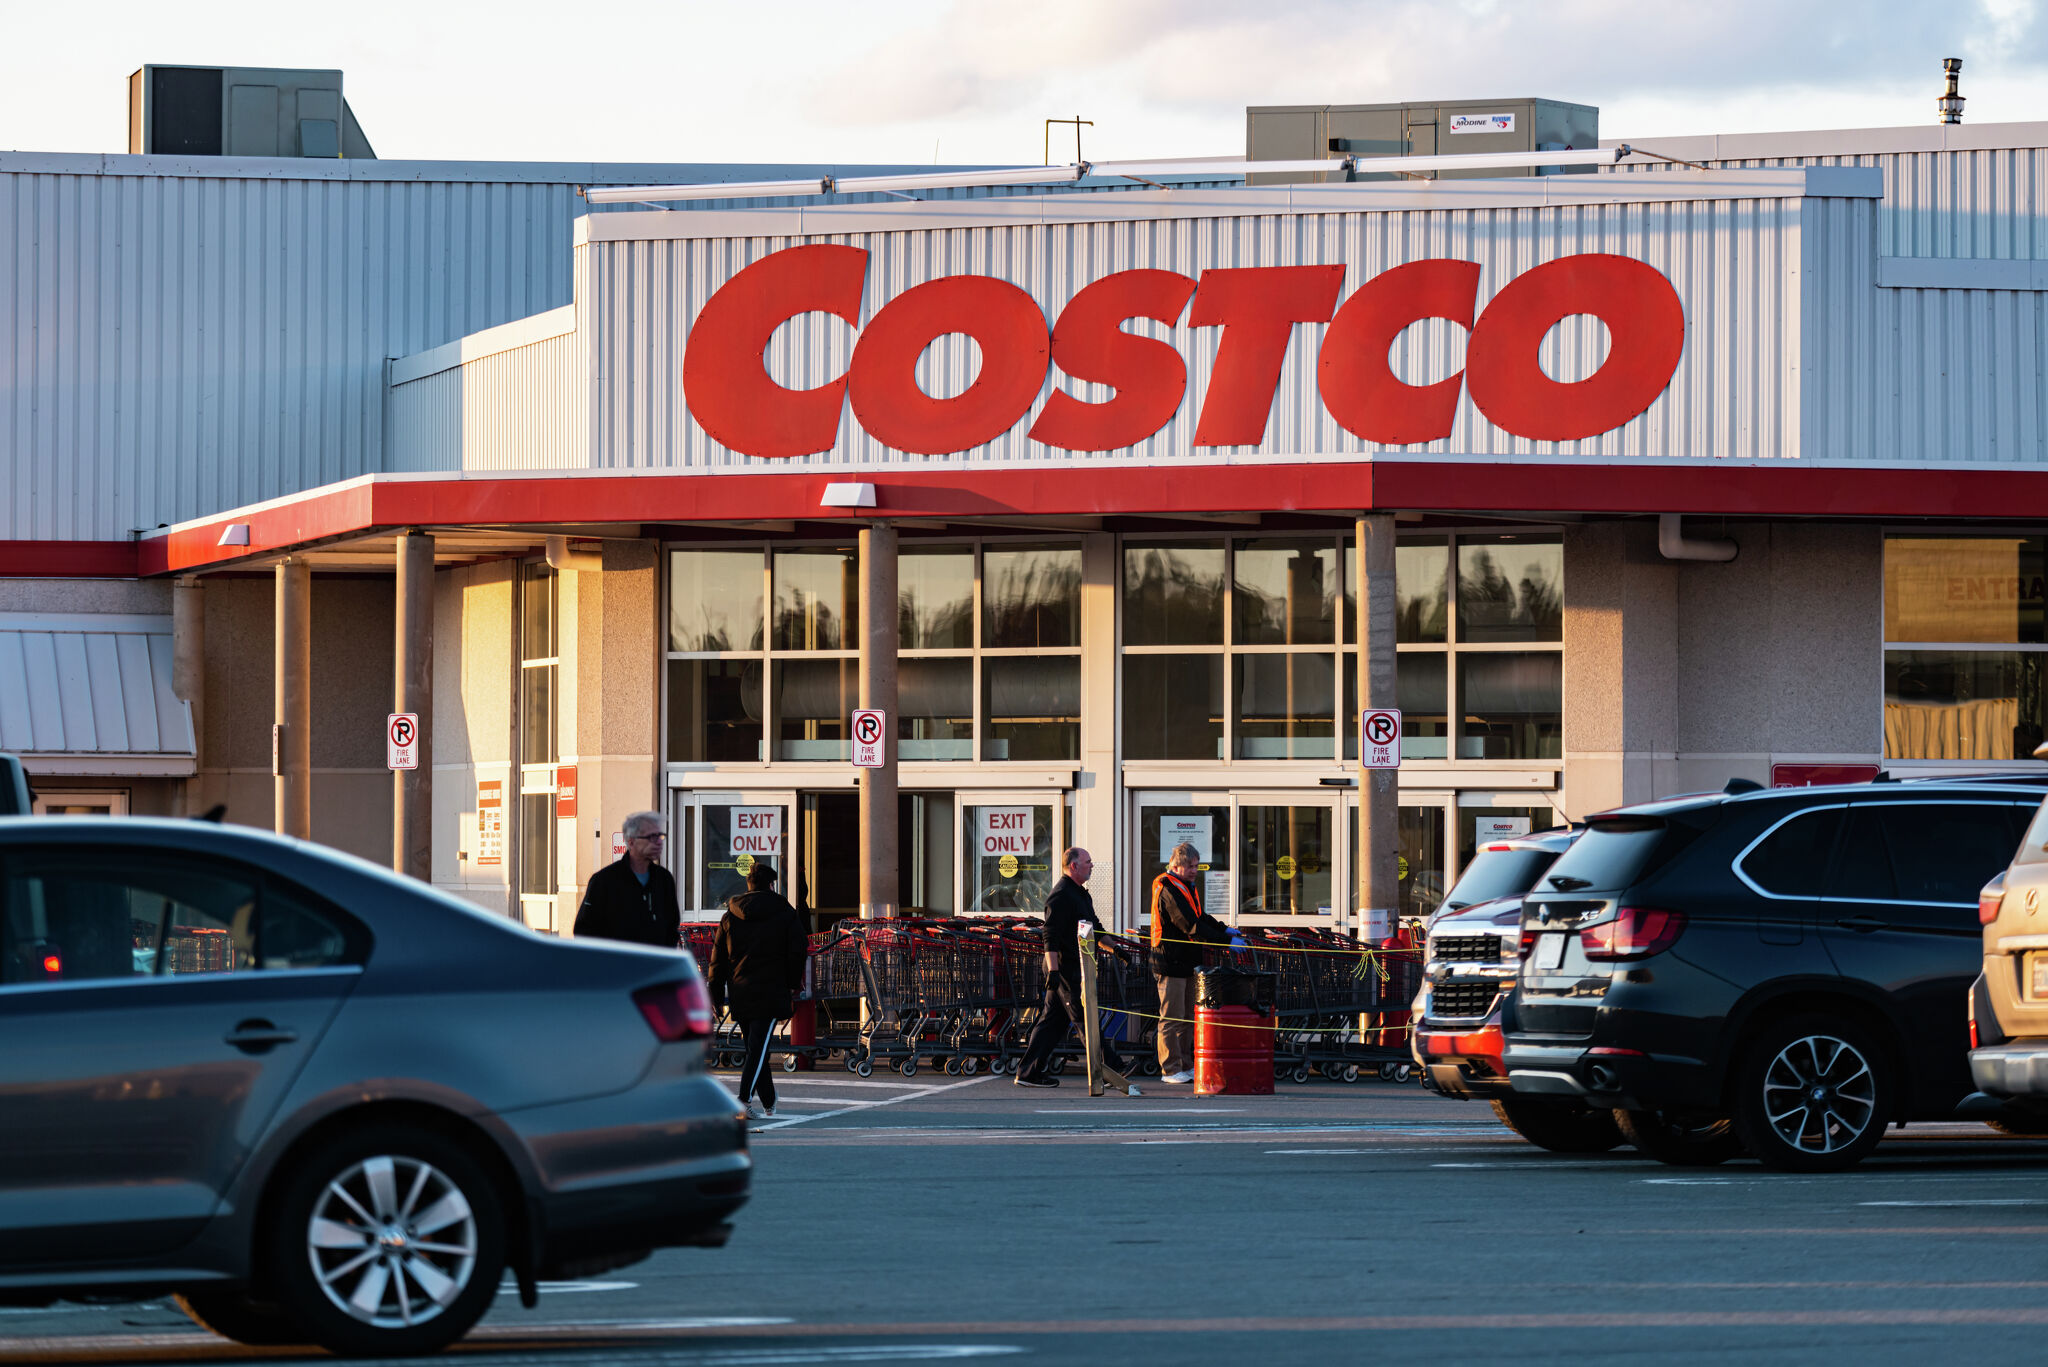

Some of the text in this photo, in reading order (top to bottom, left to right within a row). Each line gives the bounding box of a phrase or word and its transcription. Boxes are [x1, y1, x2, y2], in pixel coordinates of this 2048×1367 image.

[683, 243, 1685, 458] COSTCO
[861, 746, 875, 754] FIRE
[1373, 747, 1390, 755] FIRE
[738, 813, 774, 829] EXIT
[989, 813, 1027, 829] EXIT
[613, 845, 627, 855] SMO
[733, 835, 778, 851] ONLY
[984, 836, 1031, 852] ONLY
